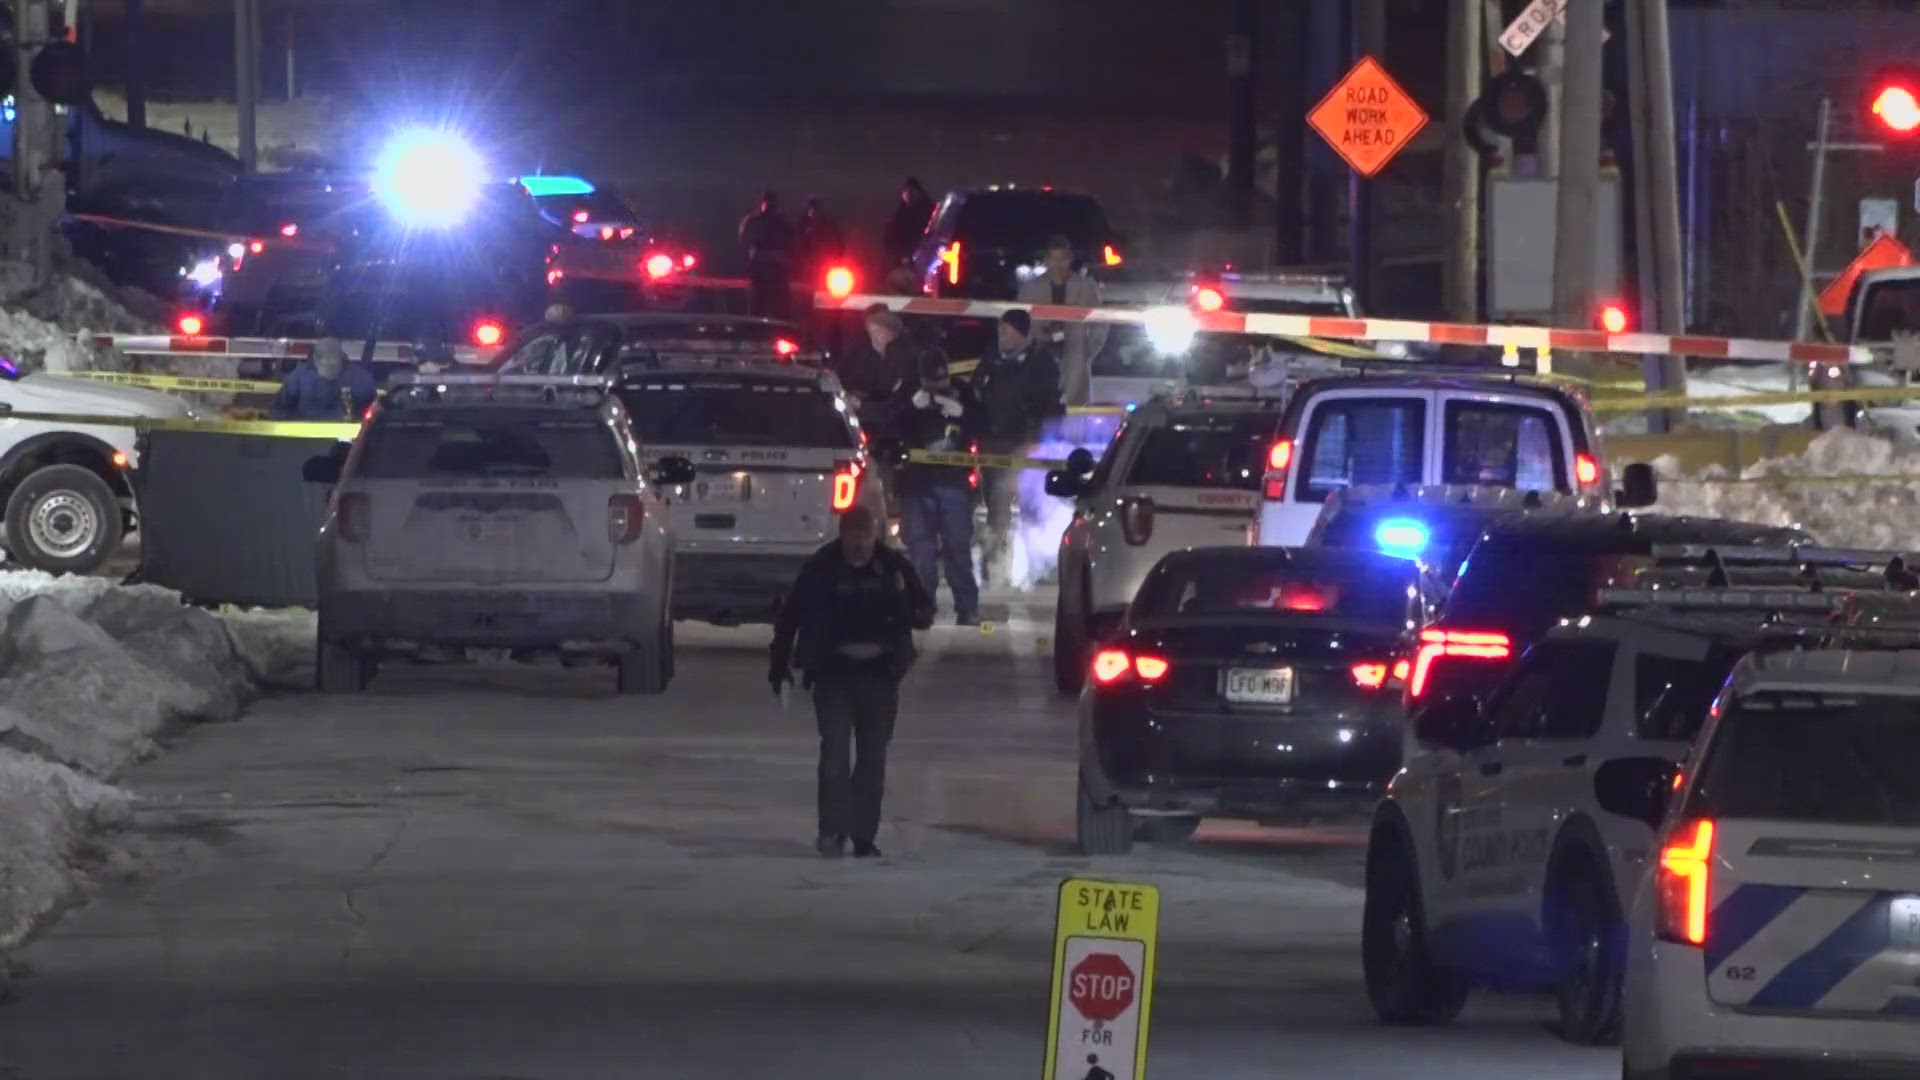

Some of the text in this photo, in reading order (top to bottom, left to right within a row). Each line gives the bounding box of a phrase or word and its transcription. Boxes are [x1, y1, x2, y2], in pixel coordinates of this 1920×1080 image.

[1346, 87, 1389, 104] ROAD
[1346, 108, 1388, 124] WORK
[1342, 128, 1396, 146] AHEAD
[1078, 887, 1143, 911] STATE
[1086, 912, 1130, 933] LAW
[1726, 967, 1756, 981] 62
[1072, 973, 1132, 1001] STOP
[1081, 1028, 1113, 1046] FOR
